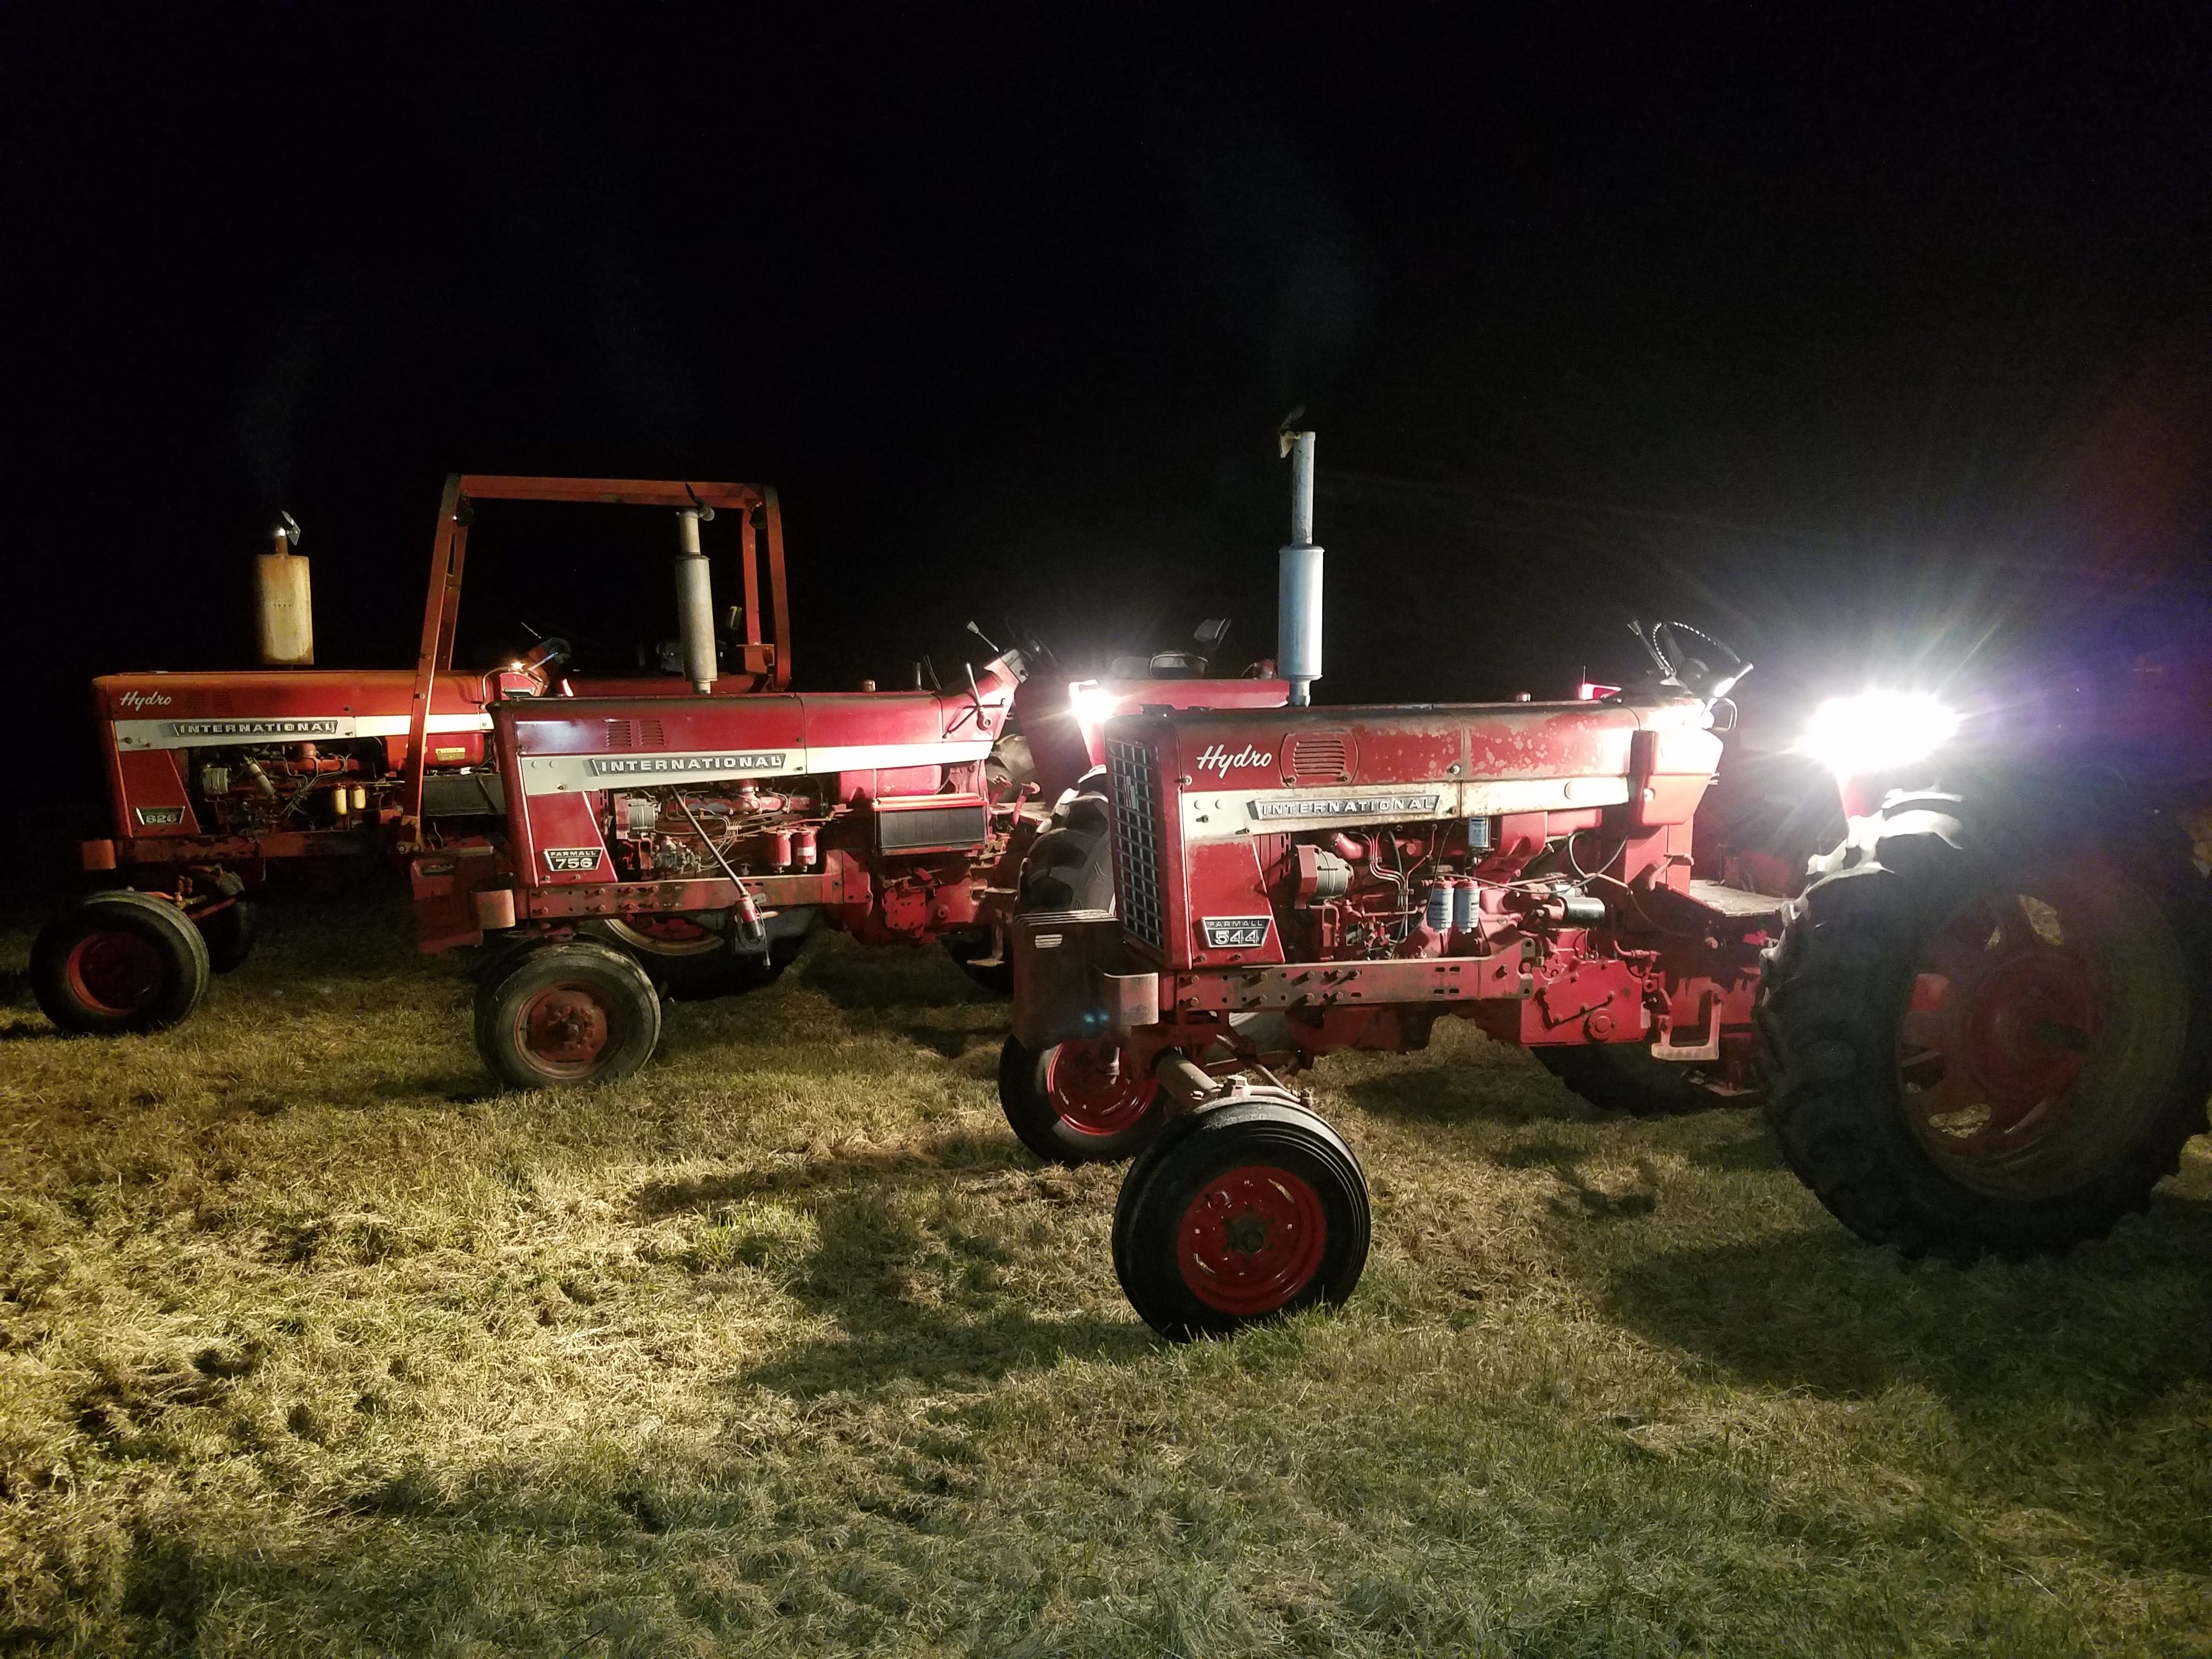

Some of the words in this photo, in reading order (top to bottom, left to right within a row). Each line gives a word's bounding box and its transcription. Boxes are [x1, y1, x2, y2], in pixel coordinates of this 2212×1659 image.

[120, 691, 172, 711] Hydro
[180, 722, 334, 733] INTERNATIONAL
[601, 755, 782, 771] INTERNATIONAL
[1197, 743, 1272, 779] Hydro
[1262, 797, 1435, 815] INTERNATIONAL
[555, 857, 593, 868] 756
[1215, 929, 1260, 945] 544
